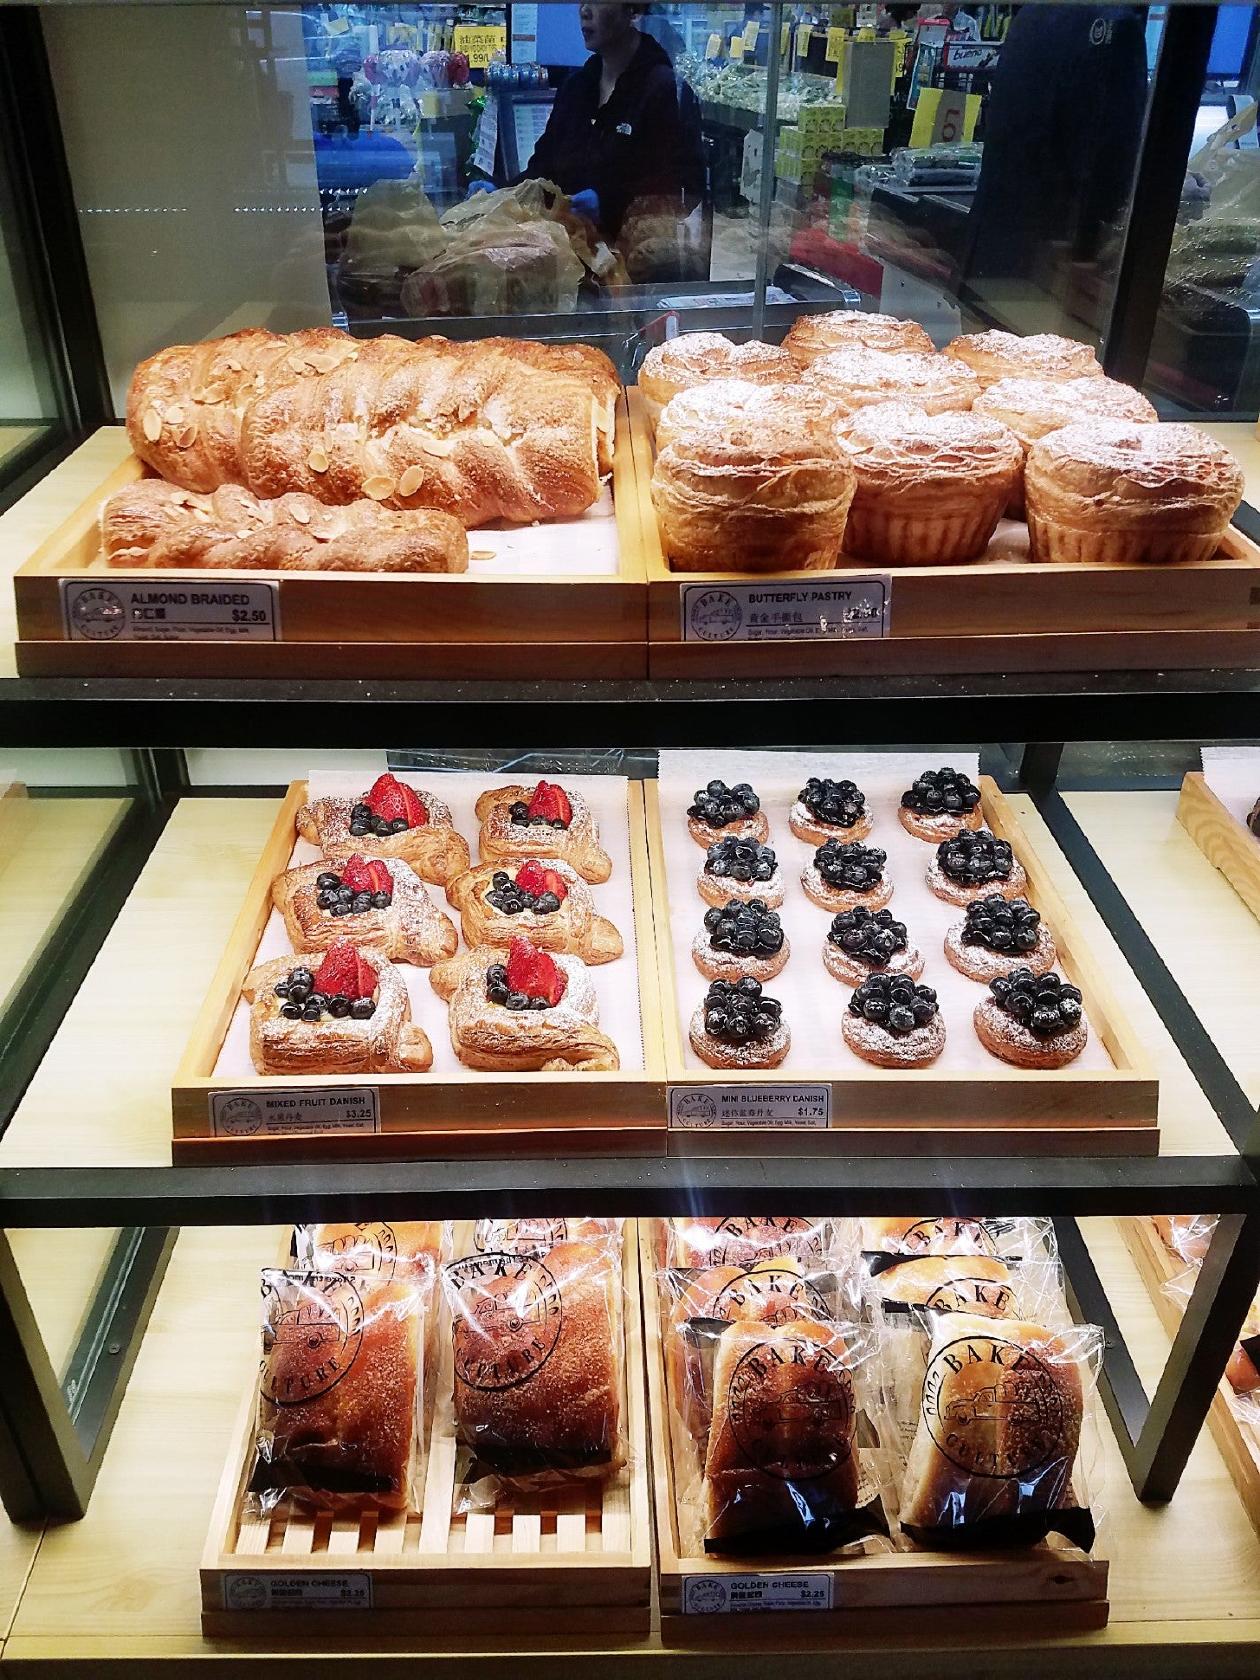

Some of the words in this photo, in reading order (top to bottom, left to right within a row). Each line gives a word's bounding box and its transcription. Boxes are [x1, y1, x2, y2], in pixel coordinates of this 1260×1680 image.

[130, 593, 188, 605] ALMOND
[190, 593, 250, 606] BRAIDED
[749, 592, 808, 604] BUTTERFLY
[811, 591, 852, 602] PASTRY
[231, 609, 267, 622] $2.50
[266, 1100, 296, 1109] MIXED
[300, 1098, 327, 1108] FRUIT
[329, 1096, 366, 1106] DANISH
[721, 1095, 739, 1103] MINI
[741, 1095, 791, 1103] BLUEBERRY
[793, 1094, 824, 1103] DANISH
[345, 1109, 372, 1119] $3.25
[797, 1107, 824, 1116] $1.75
[748, 1344, 832, 1377] BAKE
[943, 1343, 1034, 1376] BAKE
[730, 1581, 769, 1590] GOLDEN
[771, 1580, 809, 1589] CHEESE
[800, 1589, 825, 1599] $2.25
